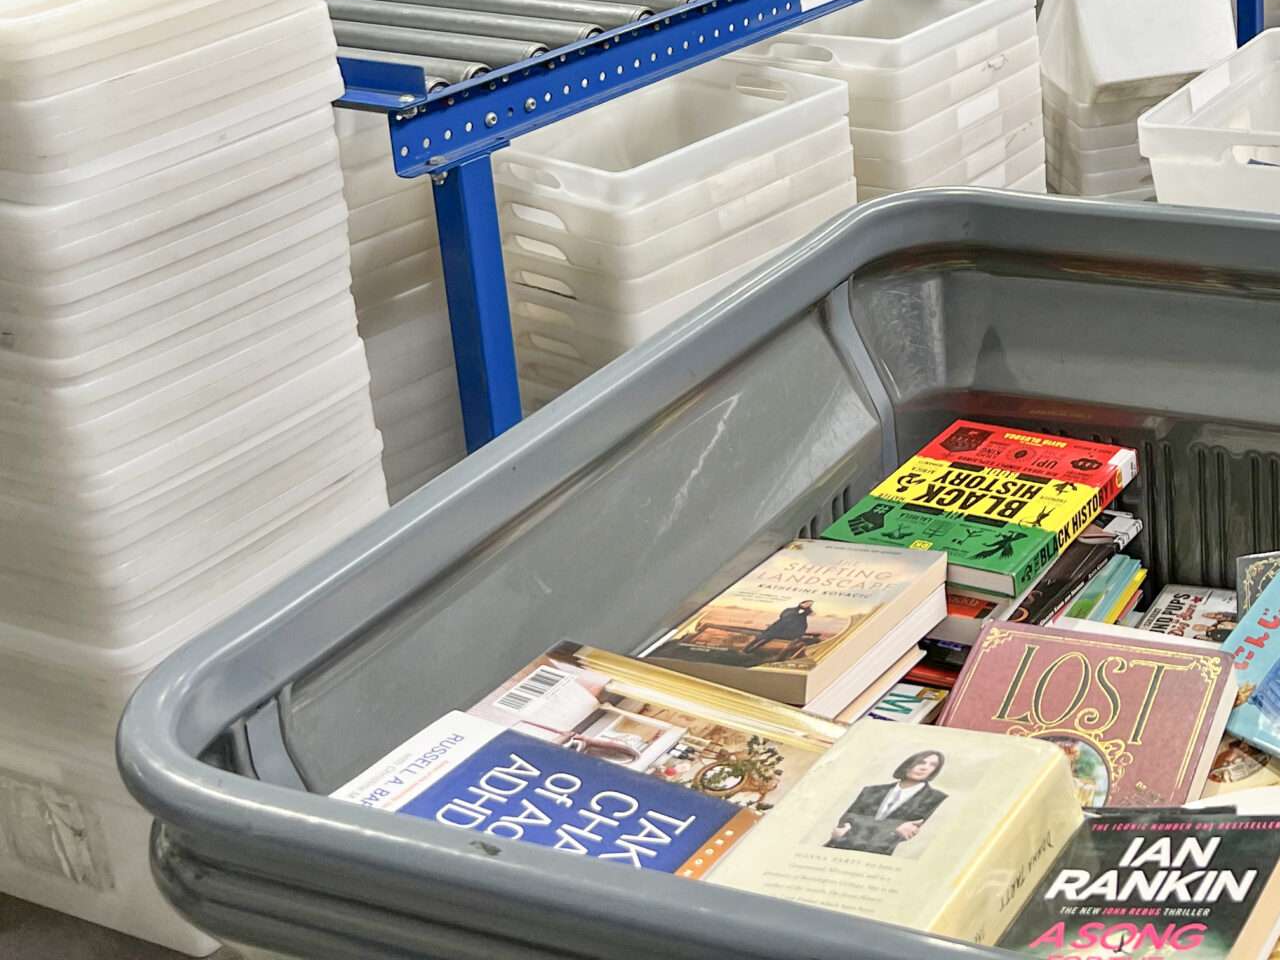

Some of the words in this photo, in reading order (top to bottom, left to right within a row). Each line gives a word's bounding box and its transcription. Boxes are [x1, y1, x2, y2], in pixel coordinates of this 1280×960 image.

[933, 469, 1047, 500] HISTORY
[912, 483, 1030, 519] BLACK
[1039, 526, 1071, 560] BLACK
[1071, 486, 1109, 534] HISTORY
[757, 570, 899, 592] LANDSCAPE
[783, 561, 893, 581] SHIFTING
[1161, 592, 1191, 617] PUPS
[991, 644, 1200, 745] LOST
[403, 732, 465, 778] RUSSELL
[435, 753, 541, 830] ADHD
[534, 772, 582, 809] of
[1091, 823, 1108, 831] THE
[1111, 822, 1148, 831] ICONIC
[1150, 822, 1192, 831] NUMBER
[1118, 836, 1222, 868] IAN
[1044, 869, 1258, 903] RANKIN
[1059, 906, 1077, 916] THE
[1079, 906, 1102, 917] NEW
[1102, 907, 1126, 916] JOHN
[1128, 907, 1161, 917] REBUS
[1163, 907, 1211, 917] THRILLER
[1028, 921, 1066, 949] A
[1071, 922, 1209, 951] SONG
